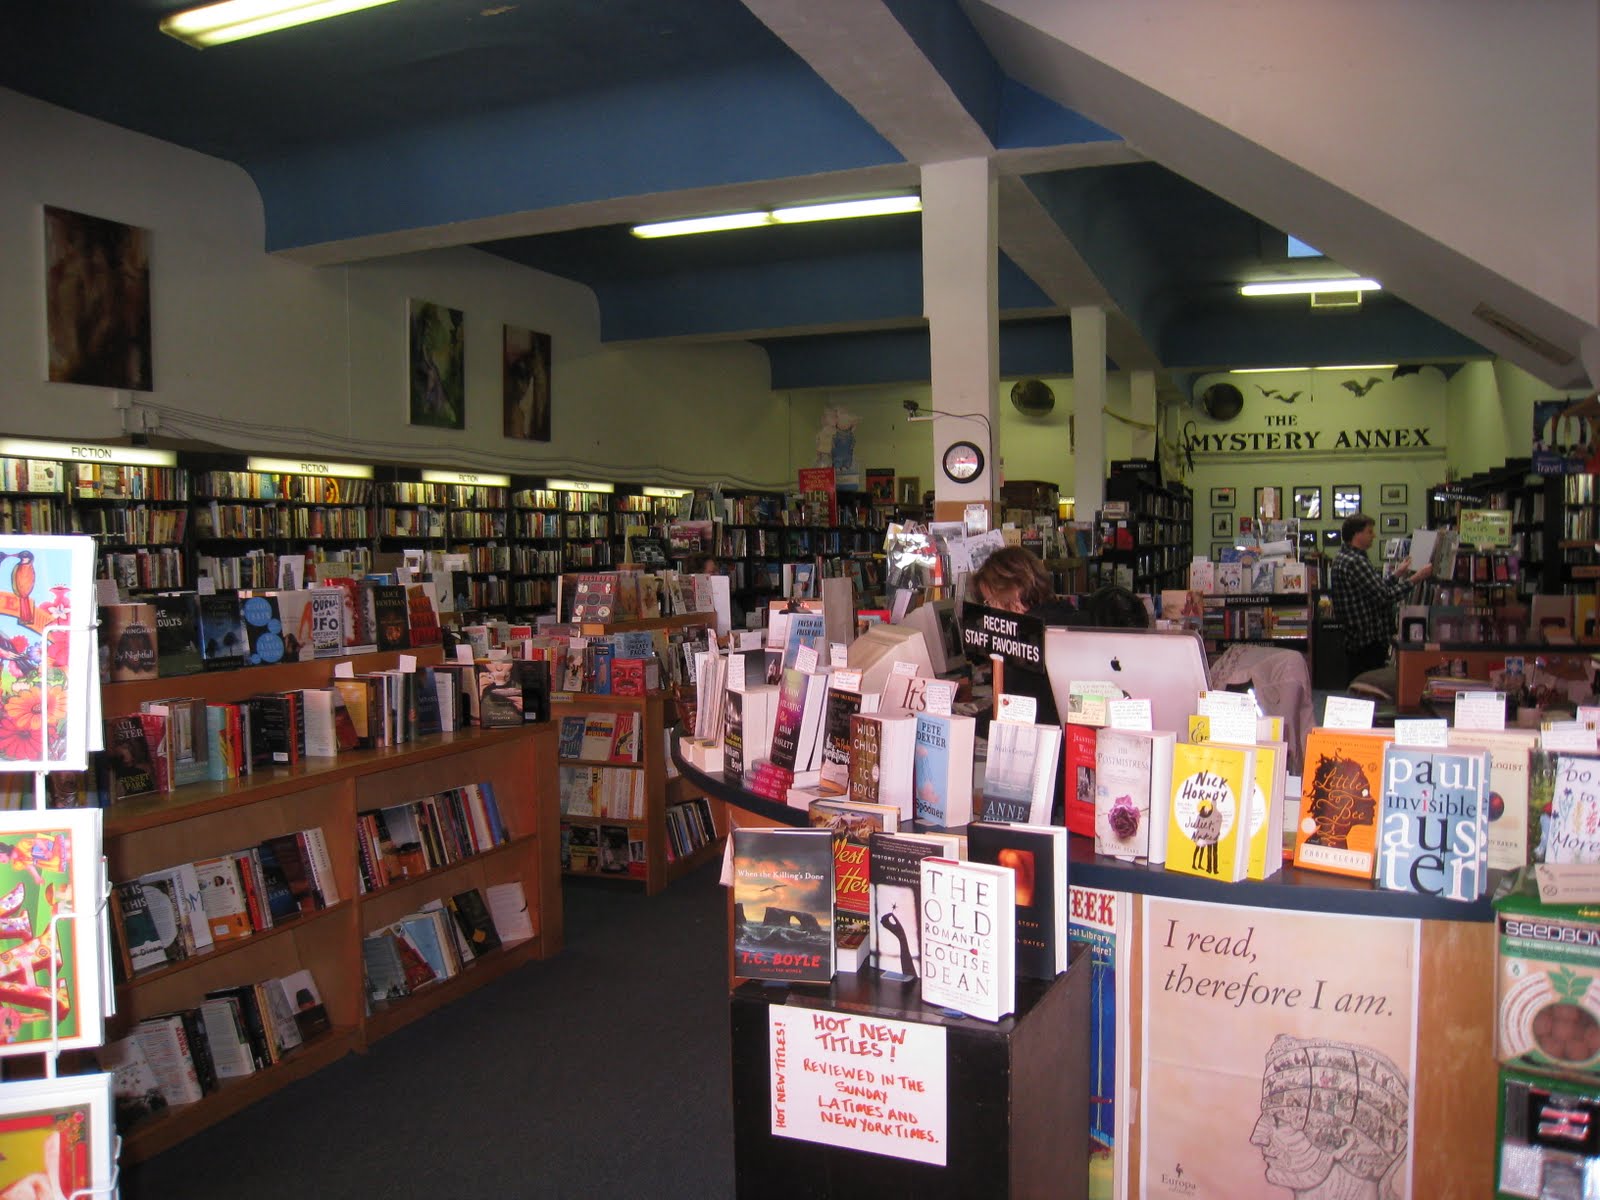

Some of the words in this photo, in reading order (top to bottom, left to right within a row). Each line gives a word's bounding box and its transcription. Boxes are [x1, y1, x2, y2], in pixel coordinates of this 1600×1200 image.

[1264, 415, 1298, 426] THE
[1190, 431, 1321, 450] MYSTERY
[1335, 428, 1430, 449] ANNEX
[71, 446, 112, 459] FICTION
[301, 463, 329, 473] FICTION
[458, 474, 480, 482] FICTION
[1537, 463, 1562, 472] Travel
[313, 600, 338, 612] OURNAL
[158, 618, 182, 627] DULTS
[983, 614, 1018, 637] RECENT
[125, 650, 153, 661] Nightfall
[965, 629, 989, 648] STAFF
[992, 635, 1040, 663] FAVORITES
[901, 678, 926, 711] It's
[857, 722, 876, 738] WILD
[917, 730, 947, 749] DEXTER
[921, 722, 942, 736] PETE
[853, 739, 878, 754] CHILD
[1097, 752, 1149, 769] POSTMISTRESS
[1490, 761, 1523, 771] LOGIST
[119, 772, 149, 784] SUNSET
[1316, 767, 1366, 790] Little
[1388, 753, 1476, 795] paul
[125, 780, 147, 791] PARK
[853, 781, 875, 799] BOYLE
[986, 801, 1025, 821] ANNE
[1388, 790, 1476, 818] invisible
[1384, 811, 1476, 858] aus
[1552, 832, 1600, 852] More
[872, 853, 895, 861] HISTORY
[1304, 849, 1329, 859] CHRIS
[1333, 854, 1366, 865] CLEAVE
[738, 869, 758, 878] When
[760, 870, 771, 878] the
[773, 871, 803, 881] Killing's
[805, 872, 824, 880] Done
[836, 867, 870, 894] Her
[1383, 848, 1476, 901] ter
[926, 869, 991, 907] THE
[924, 899, 991, 937] OLD
[1070, 889, 1115, 927] EEK
[925, 923, 991, 950] ROMANTIC
[1069, 928, 1079, 936] cal
[1081, 930, 1110, 944] Library
[1164, 918, 1180, 949] I
[1188, 926, 1258, 963] read,
[741, 951, 768, 965] T.C.
[772, 952, 821, 968] BOYLE
[925, 943, 990, 975] LOUISE
[925, 961, 990, 997] DEAN
[1164, 963, 1302, 1008] therefore
[1309, 980, 1328, 1010] I
[1335, 991, 1394, 1017] am.
[812, 1014, 852, 1033] HOT
[859, 1023, 907, 1045] NEW
[774, 1022, 786, 1069] TITLES!
[803, 1058, 875, 1084] REVIEWED
[881, 1074, 895, 1086] IN
[898, 1076, 926, 1093] THE
[775, 1074, 786, 1103] NEW
[835, 1080, 888, 1105] SUNDAY
[775, 1104, 787, 1129] HOT
[841, 1098, 884, 1118] TIMES
[887, 1109, 918, 1125] AND
[820, 1110, 857, 1129] NEW
[859, 1117, 893, 1137] YORK
[895, 1124, 939, 1144] TIMES.
[1162, 1173, 1197, 1190] Europa
